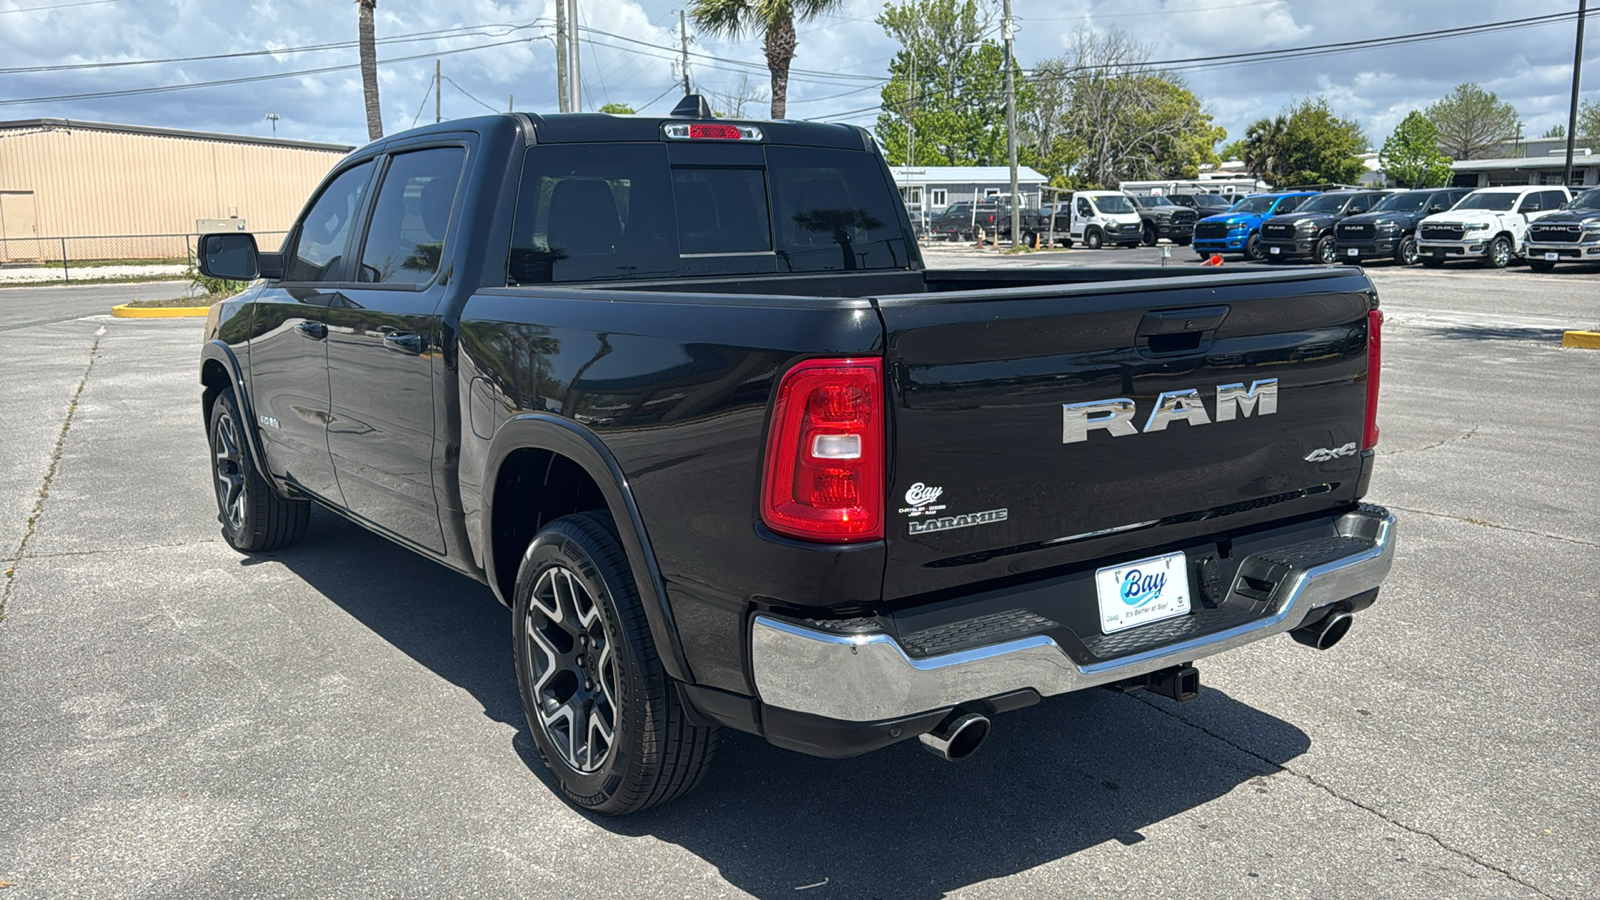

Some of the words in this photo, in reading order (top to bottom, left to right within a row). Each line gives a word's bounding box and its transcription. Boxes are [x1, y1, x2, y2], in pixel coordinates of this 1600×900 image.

[1062, 377, 1279, 444] RAM
[905, 482, 943, 504] Bay
[898, 506, 926, 514] CHRYSLER
[908, 508, 1008, 535] LARAMIE
[1122, 569, 1168, 599] Bay
[1134, 608, 1150, 616] Better
